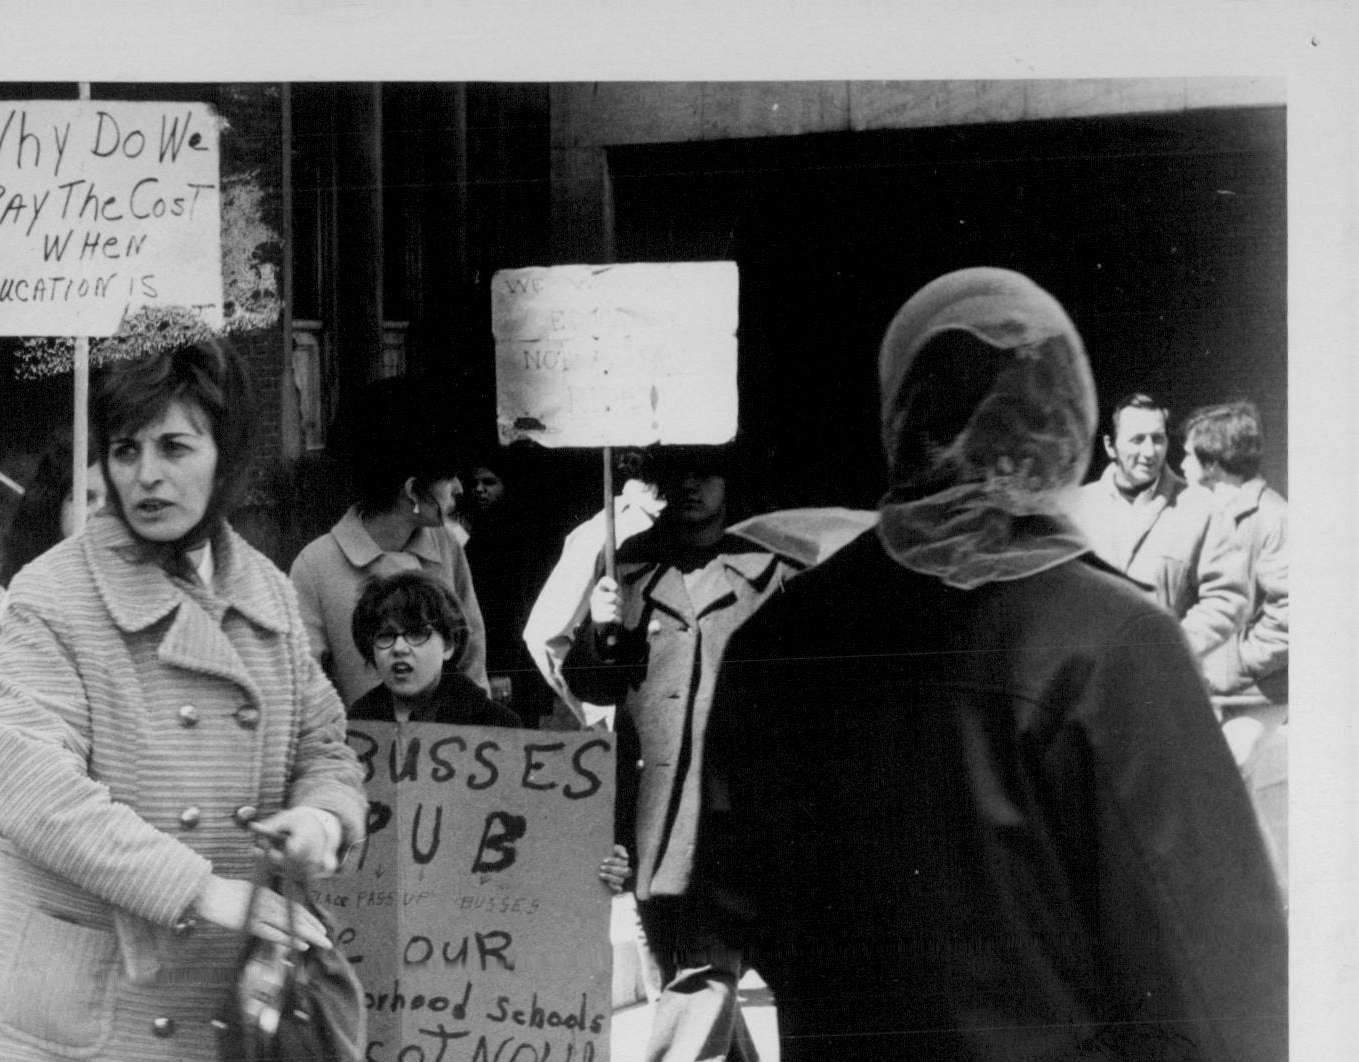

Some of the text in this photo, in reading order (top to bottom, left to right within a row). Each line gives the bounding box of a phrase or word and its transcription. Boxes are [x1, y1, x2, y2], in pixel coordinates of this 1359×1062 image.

[91, 110, 146, 159] Do
[158, 109, 210, 164] We
[57, 178, 124, 222] The
[128, 273, 158, 298] IS
[403, 929, 516, 972] OUR
[485, 992, 607, 1035] Schools
